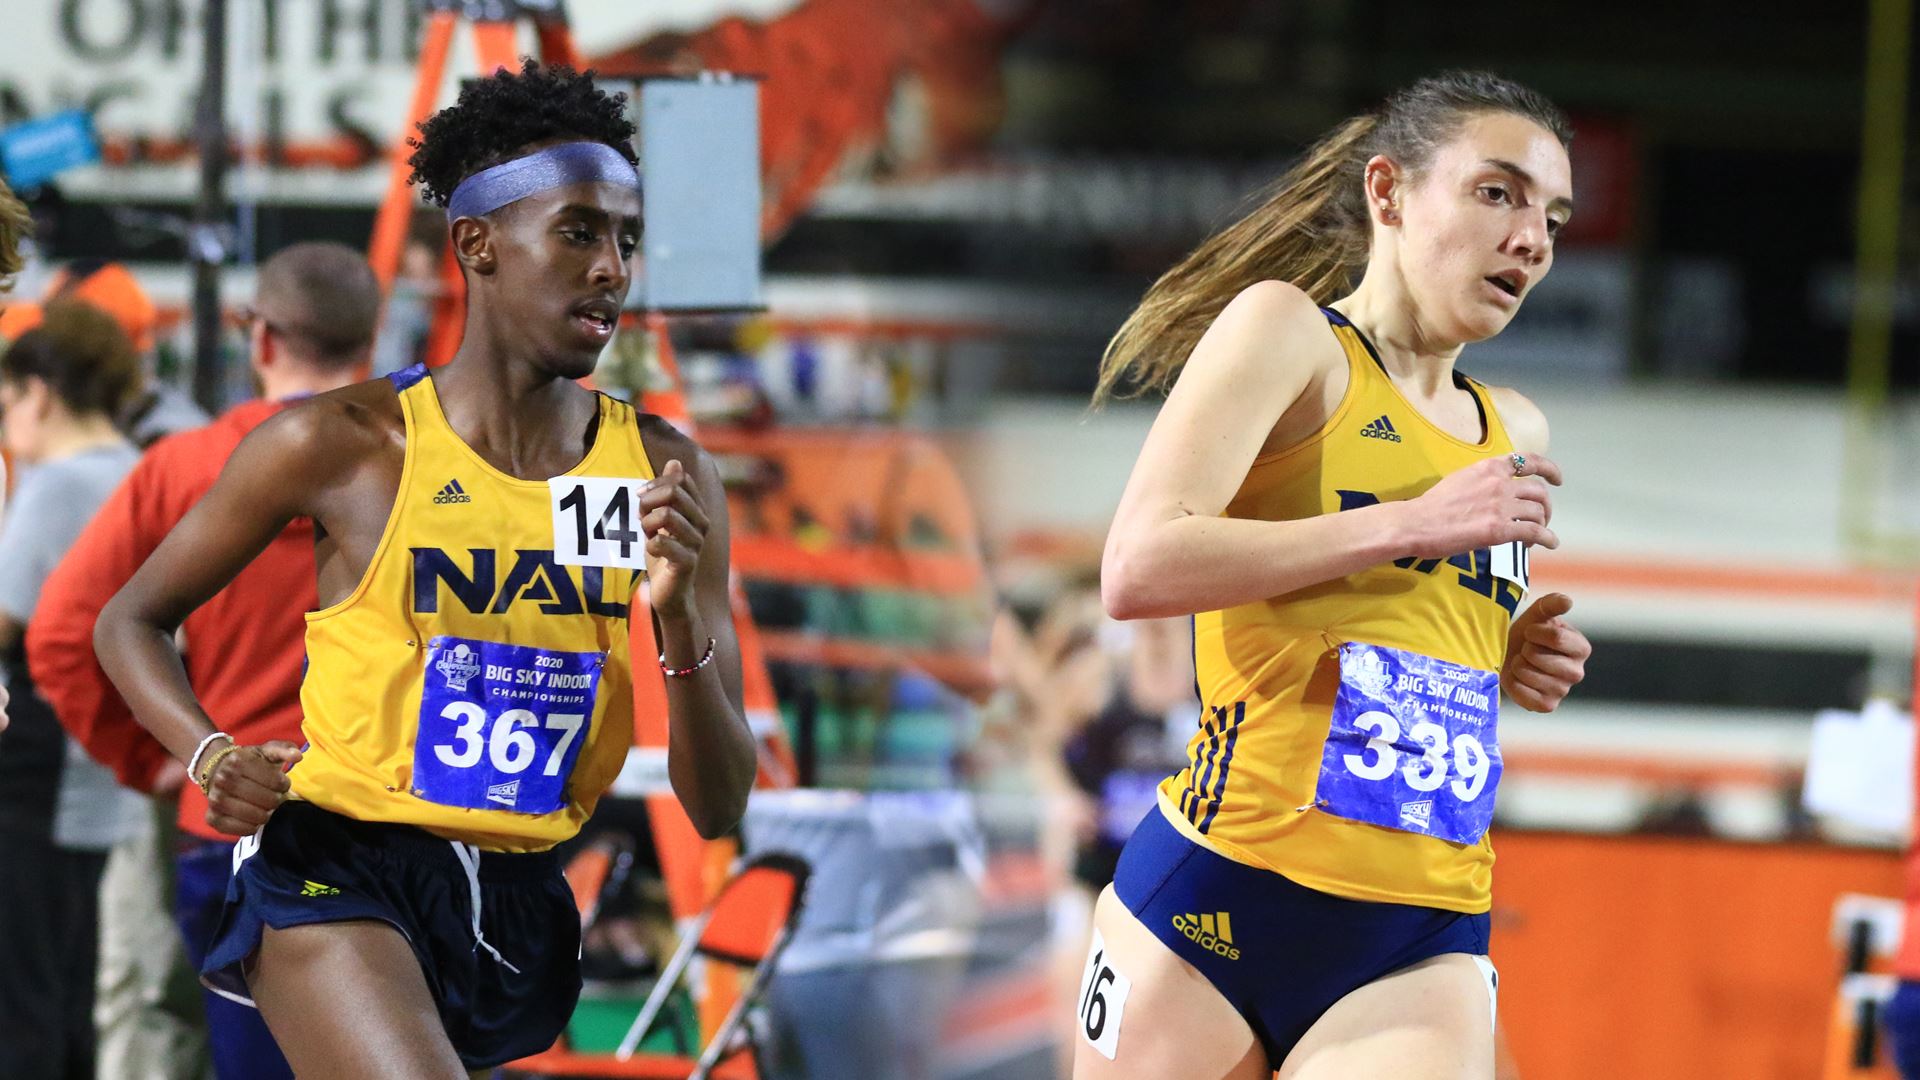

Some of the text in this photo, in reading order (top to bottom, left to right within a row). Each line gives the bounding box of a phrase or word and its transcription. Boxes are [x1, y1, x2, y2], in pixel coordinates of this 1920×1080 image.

[1360, 427, 1402, 443] adidas
[433, 493, 471, 505] adidas
[560, 484, 638, 559] 14
[534, 655, 564, 669] 2020
[485, 664, 513, 682] BIG
[515, 669, 546, 686] SKY
[547, 673, 593, 689] INDOOR
[1399, 673, 1424, 694] BIG
[1426, 679, 1456, 700] SKY
[492, 687, 585, 703] CHAMPIONSHIPS
[433, 701, 585, 777] 367
[1343, 710, 1490, 803] 339
[1171, 914, 1241, 961] adidas
[1081, 949, 1116, 1041] 16
